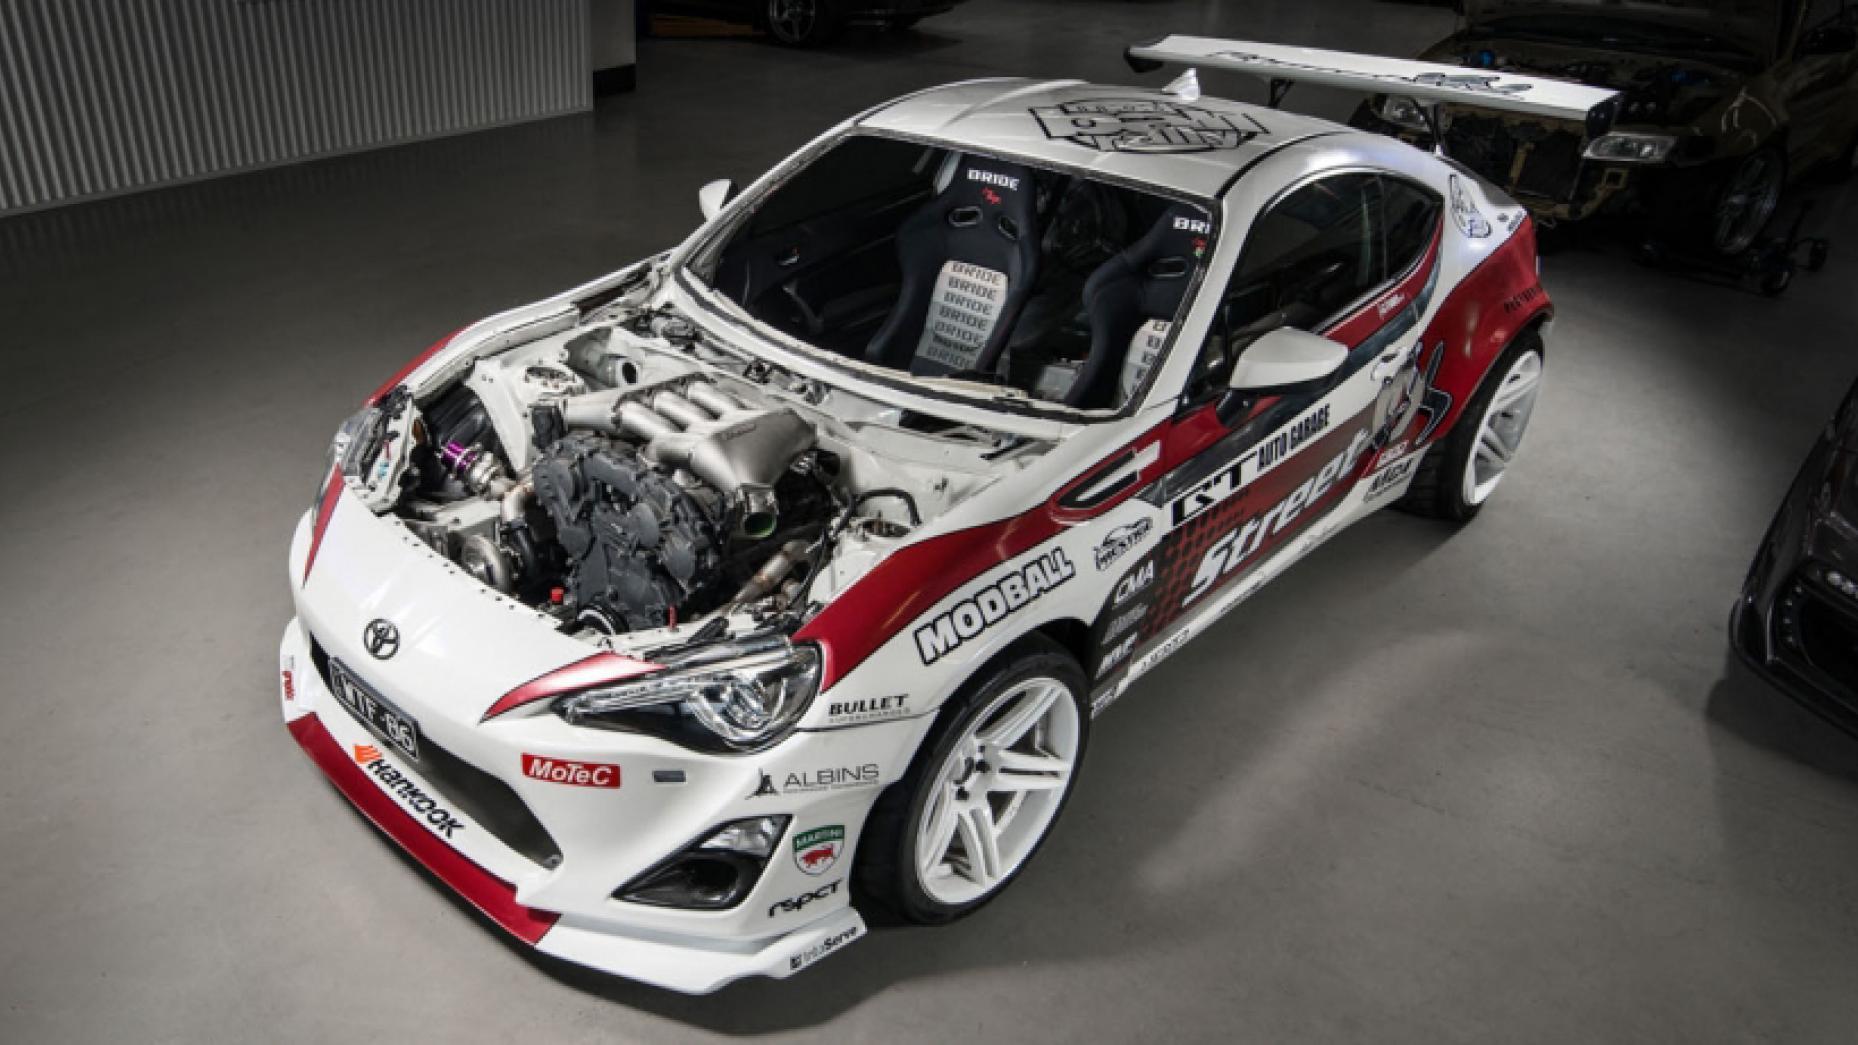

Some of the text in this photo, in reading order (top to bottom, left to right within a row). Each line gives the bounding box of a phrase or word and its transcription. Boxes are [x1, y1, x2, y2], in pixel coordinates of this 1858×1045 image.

[967, 169, 1020, 191] BRIDE
[1173, 216, 1211, 234] BRI
[1256, 431, 1288, 472] AUTO
[1290, 402, 1331, 451] GARAGE
[1182, 428, 1371, 607] Street
[913, 546, 1077, 666] MODBALL
[828, 693, 909, 717] BULLET
[529, 757, 612, 785] MoTeC
[784, 763, 880, 787] ALBINS
